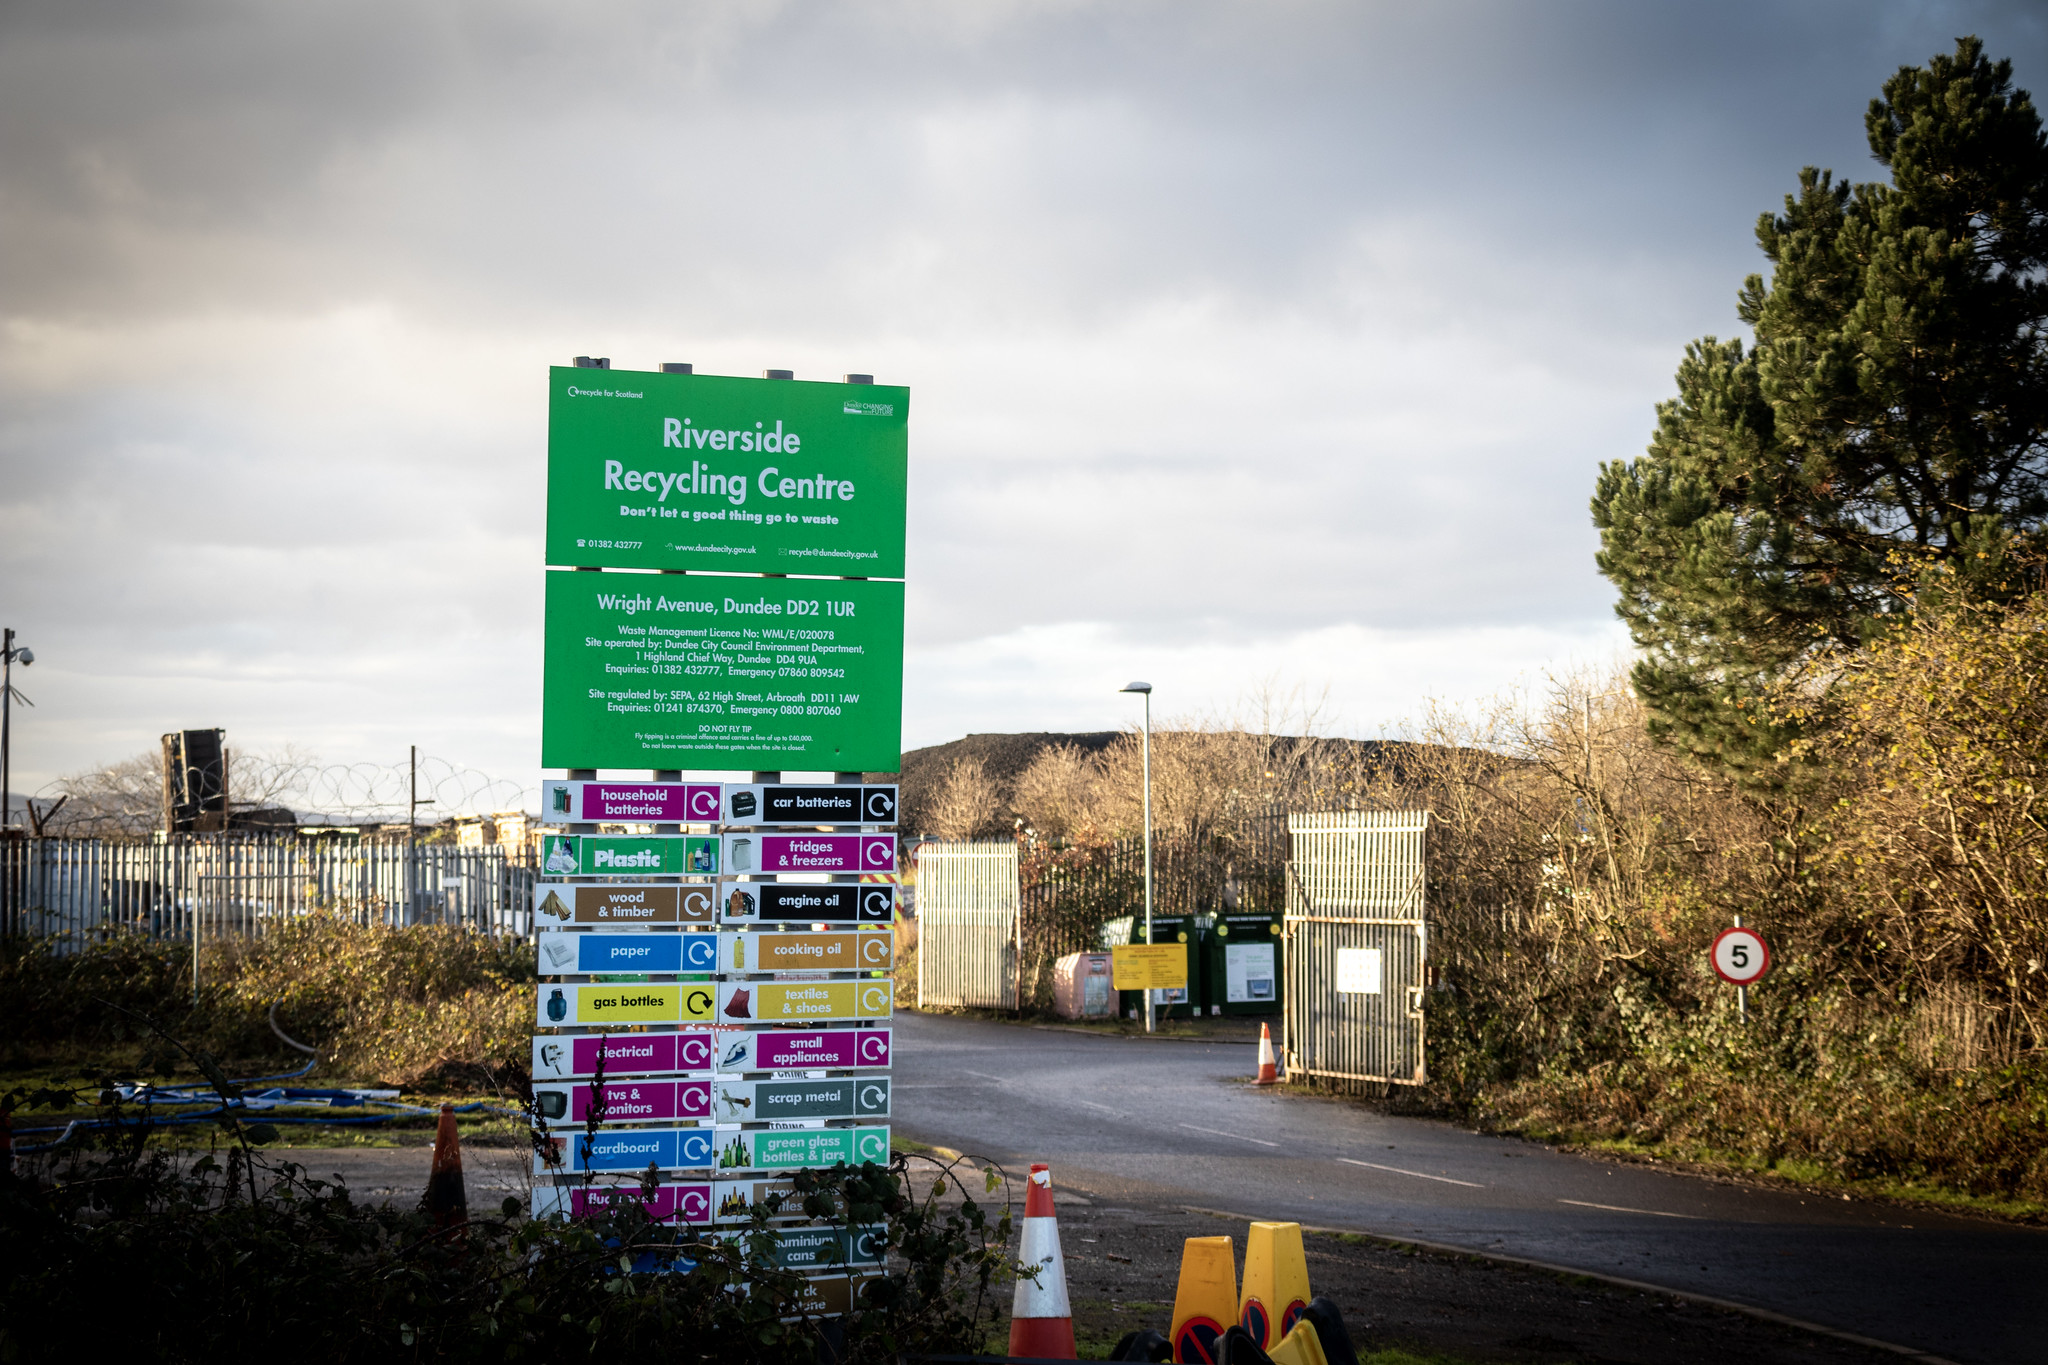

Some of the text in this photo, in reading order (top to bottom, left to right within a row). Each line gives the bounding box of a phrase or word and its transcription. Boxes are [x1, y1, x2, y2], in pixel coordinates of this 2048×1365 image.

[578, 389, 643, 399] recycle for Scotland
[863, 403, 893, 411] CHANGING
[664, 417, 800, 454] Riverside
[605, 459, 855, 505] Recycling Centre
[620, 505, 657, 517] Don't
[660, 506, 678, 518] let
[693, 509, 726, 522] good
[729, 510, 762, 524] thing
[766, 514, 782, 525] go
[785, 513, 799, 523] to
[801, 515, 839, 525] waste
[588, 539, 643, 549] 01382 432777
[675, 543, 756, 555] www.dundeecity.gov.uk
[789, 548, 878, 560] recycle@dundeecity.gov.uk
[597, 593, 855, 617] Wright Avenue, Dundee DD2 1UR
[618, 625, 834, 640] Waste Management Licence No: WML/E/020078
[585, 637, 864, 655] Site operated by: Dundee City Council Environment Department,
[636, 651, 817, 665] 1 Highland Chief Way, Dundee DD4 9UA
[605, 663, 845, 679] Enquiries: 01382 432777, Emergency 07860 809542
[589, 688, 860, 703] Site regulated by: SEPA, 62 High Street, Arbroath DD11 1AW
[607, 702, 841, 717] Enquiries: 01241 874370, Emergency 0800 807060
[729, 725, 740, 733] FLY
[742, 725, 752, 733] TIP
[635, 732, 643, 740] Fly
[644, 733, 664, 741] tipping
[601, 788, 667, 801] household
[605, 802, 663, 815] batteries
[773, 796, 852, 808] car batteries
[789, 840, 833, 855] fridges
[594, 849, 660, 867] Plastic
[779, 854, 843, 866] & freezers
[609, 891, 644, 903] wood
[779, 894, 839, 908] engine oil
[598, 905, 655, 917] & timber
[611, 948, 650, 958] paper
[774, 942, 841, 957] cooking oil
[1732, 945, 1749, 969] 5
[785, 988, 829, 1000] textiles
[594, 995, 664, 1010] gas bottles
[782, 1002, 832, 1014] & shoes
[790, 1036, 822, 1049] small
[773, 1050, 839, 1065] appliances
[607, 1088, 640, 1100] tvs &
[768, 1089, 841, 1105] scrap metal
[596, 1102, 652, 1115] onitors
[592, 1141, 659, 1154] cardboard
[768, 1136, 840, 1151] green glass
[762, 1149, 845, 1163] bottles & jars
[787, 1252, 815, 1261] cans
